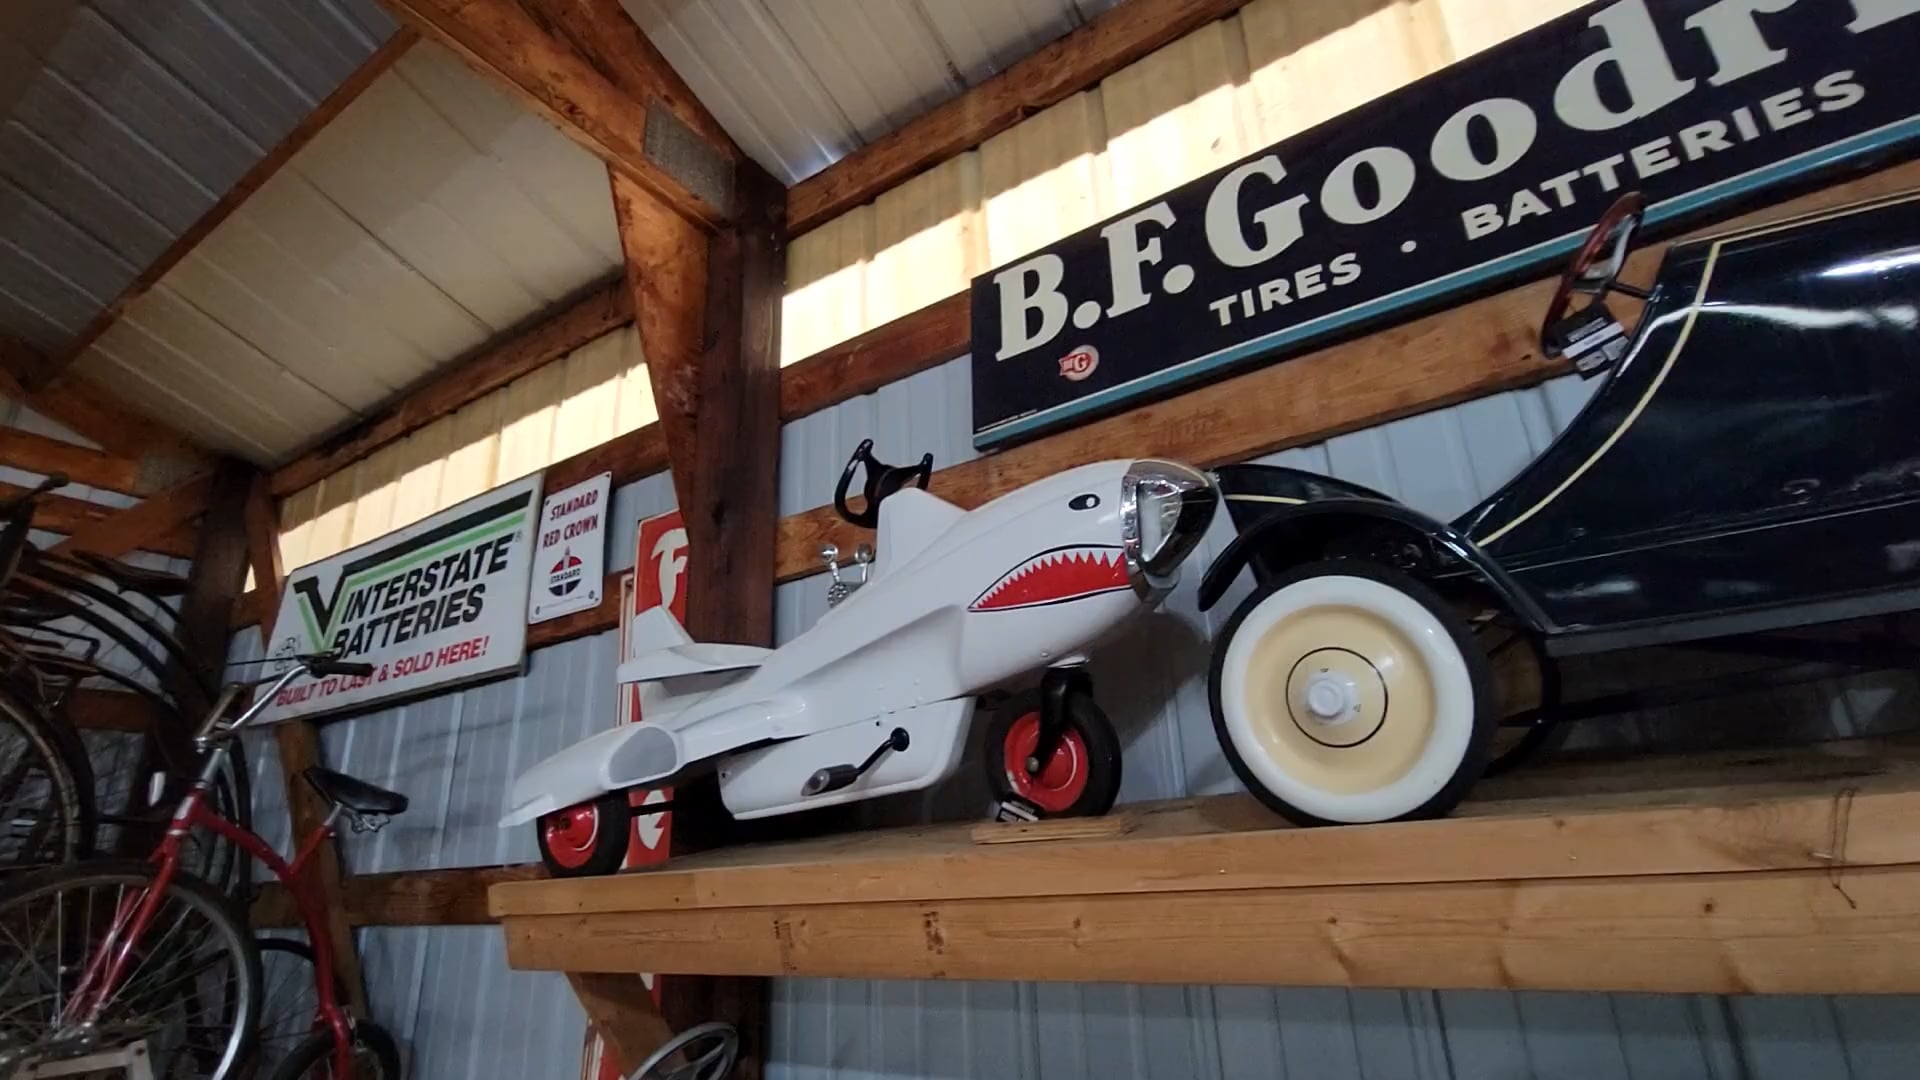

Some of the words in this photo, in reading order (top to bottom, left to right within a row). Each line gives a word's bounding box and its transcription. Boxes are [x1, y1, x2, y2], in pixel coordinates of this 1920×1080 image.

[1209, 252, 1362, 326] TIRES
[1461, 69, 1866, 241] BATTERIES
[543, 527, 561, 549] RED
[563, 514, 599, 541] CROWN
[550, 489, 598, 520] STANDARD
[341, 533, 515, 625] INTERSTATE
[331, 583, 486, 660] BATTERIES
[319, 676, 338, 696] TO
[378, 664, 389, 682] &
[393, 651, 434, 678] SOLD
[436, 635, 490, 668] HERE!
